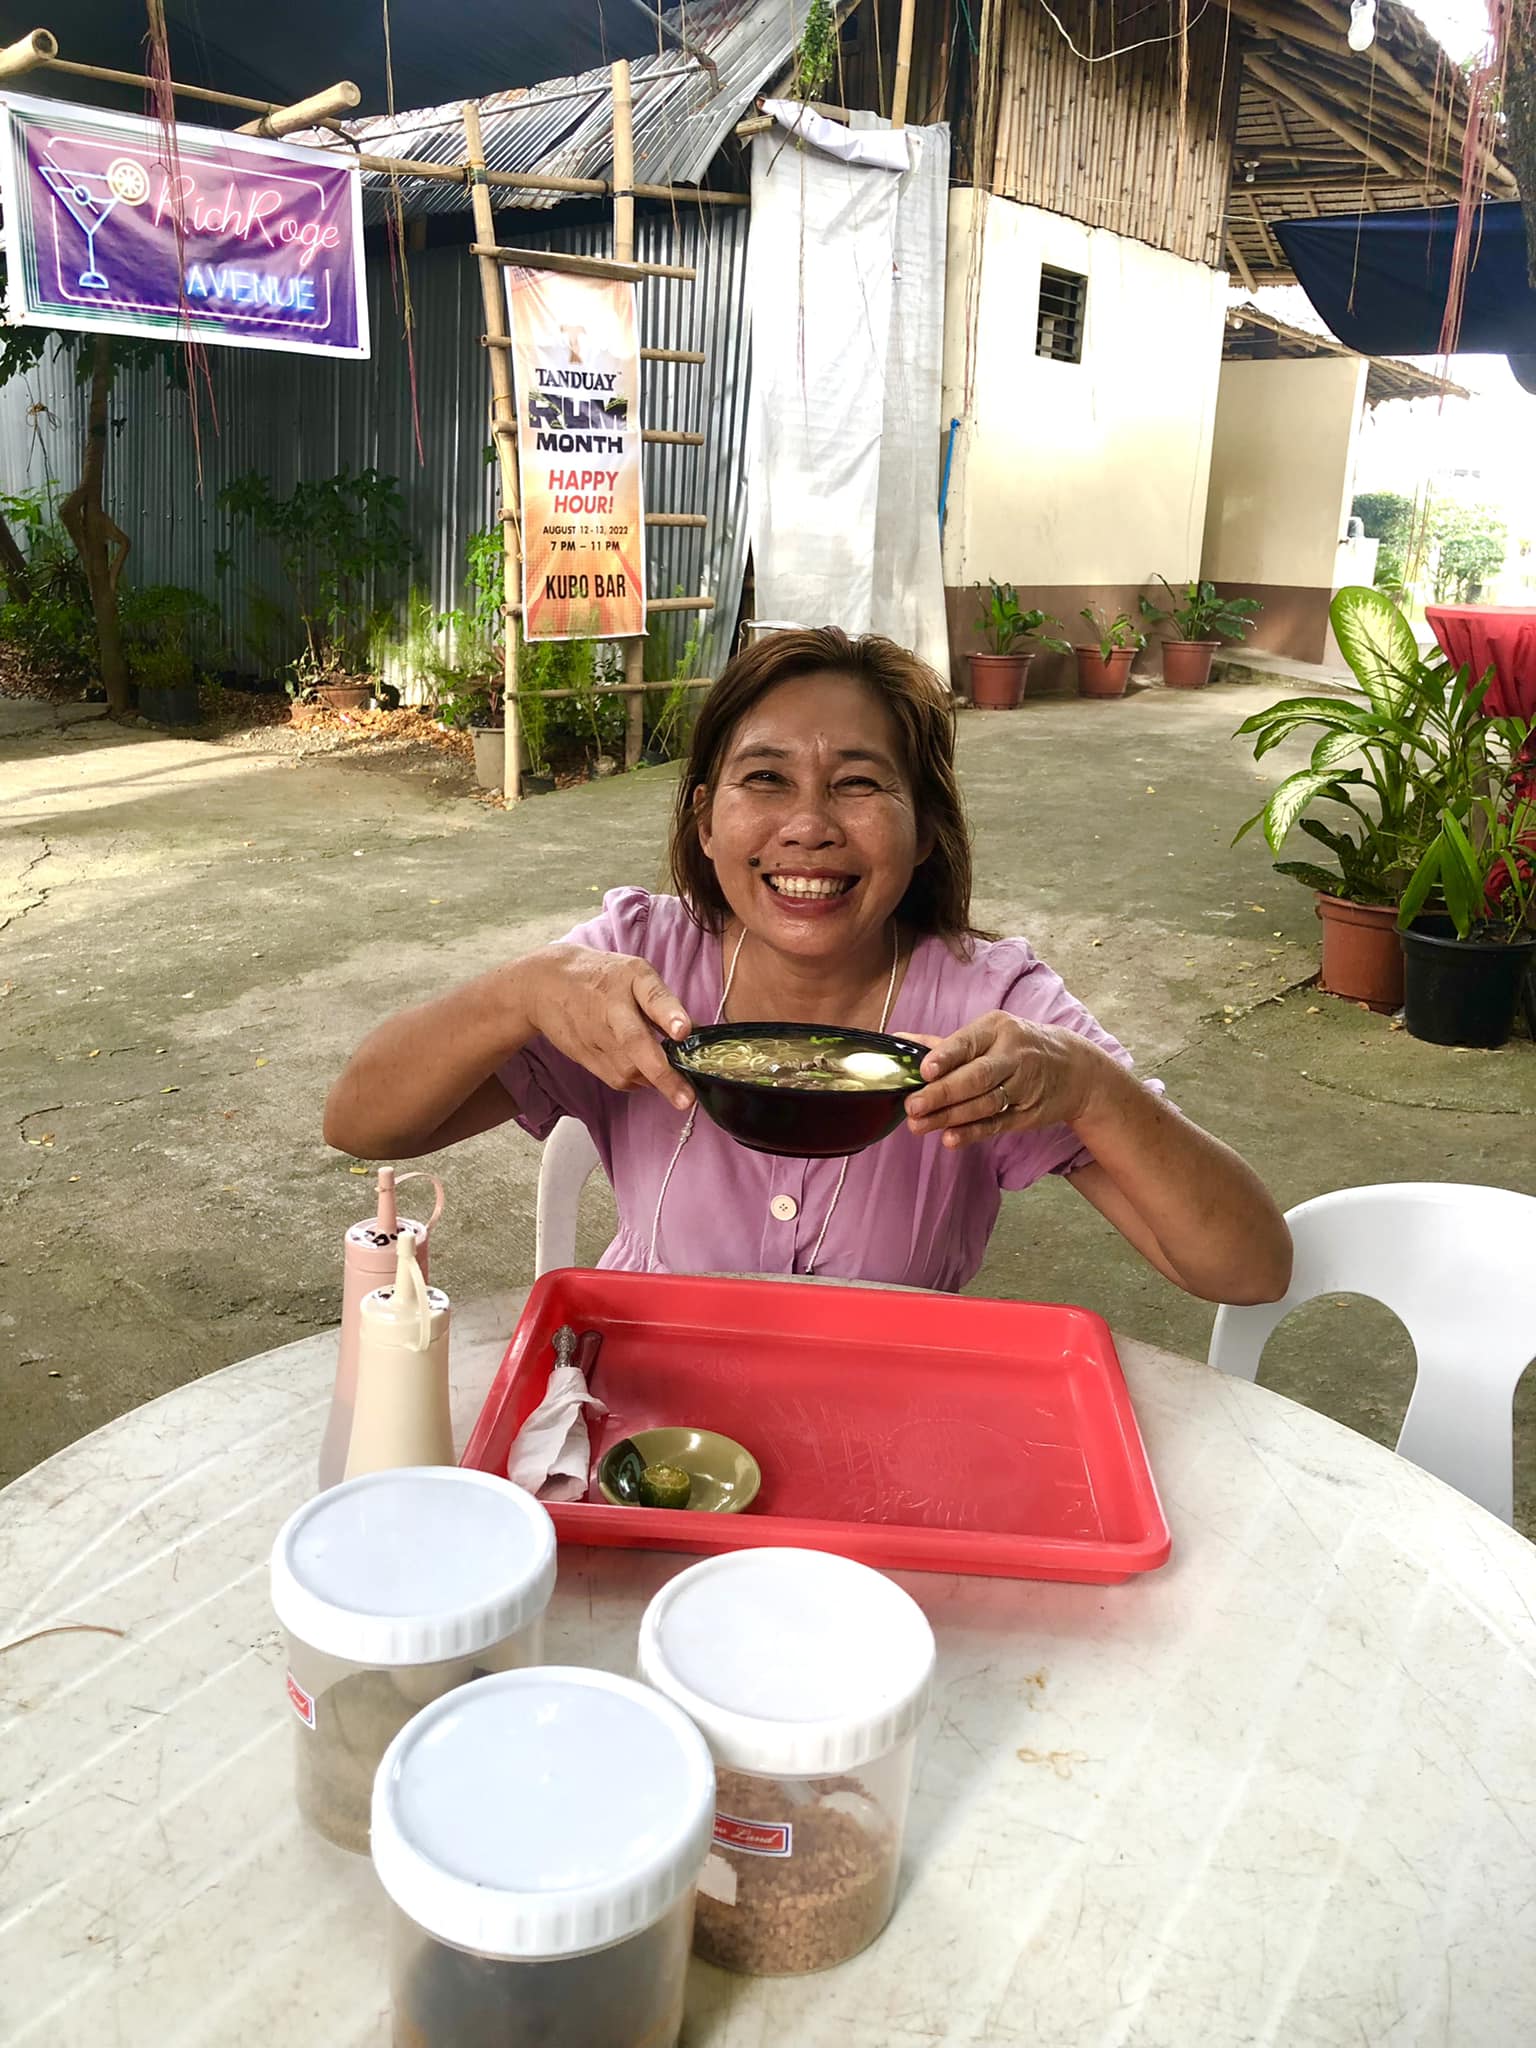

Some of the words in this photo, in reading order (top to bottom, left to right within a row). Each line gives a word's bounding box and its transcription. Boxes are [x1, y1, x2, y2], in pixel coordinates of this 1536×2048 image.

[186, 265, 316, 311] AVENUE
[535, 368, 617, 391] TANDUAY
[528, 392, 629, 430] RUM
[536, 432, 623, 454] MONTH
[548, 469, 619, 491] HAPPY
[554, 495, 614, 514] HOUR!
[543, 525, 576, 535] AUGUST
[609, 525, 628, 535] 2022
[550, 541, 557, 551] 7
[560, 541, 576, 551] PM
[591, 541, 601, 551] 11
[605, 541, 620, 551] PM
[545, 574, 588, 599] KUBO
[594, 574, 626, 598] BAR
